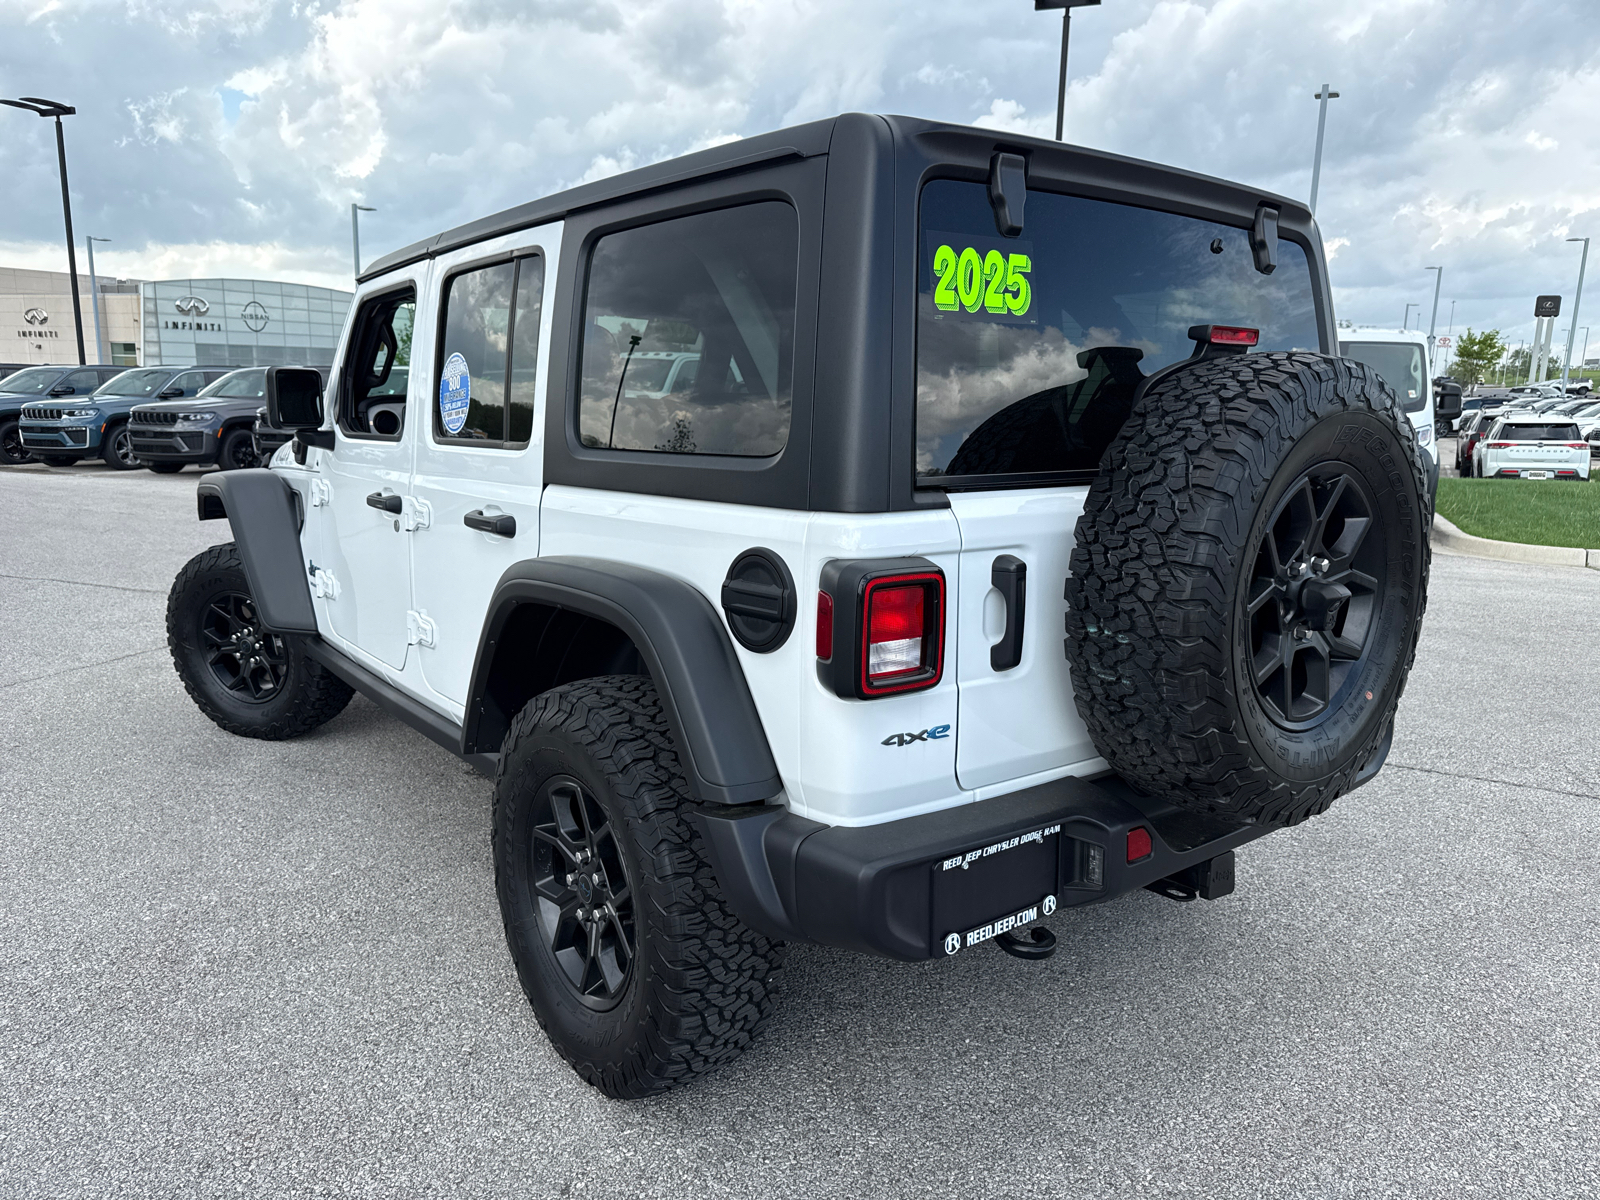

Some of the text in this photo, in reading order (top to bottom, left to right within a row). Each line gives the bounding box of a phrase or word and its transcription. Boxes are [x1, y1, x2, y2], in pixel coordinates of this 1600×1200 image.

[934, 245, 1031, 316] 2025
[165, 321, 222, 332] INFINITI
[241, 313, 270, 321] NISSAN
[17, 330, 59, 339] INFINITI
[943, 824, 1061, 871] REED JEEP CHRYSLER DODGE RAM
[966, 907, 1038, 947] REEDJEEP.COM
